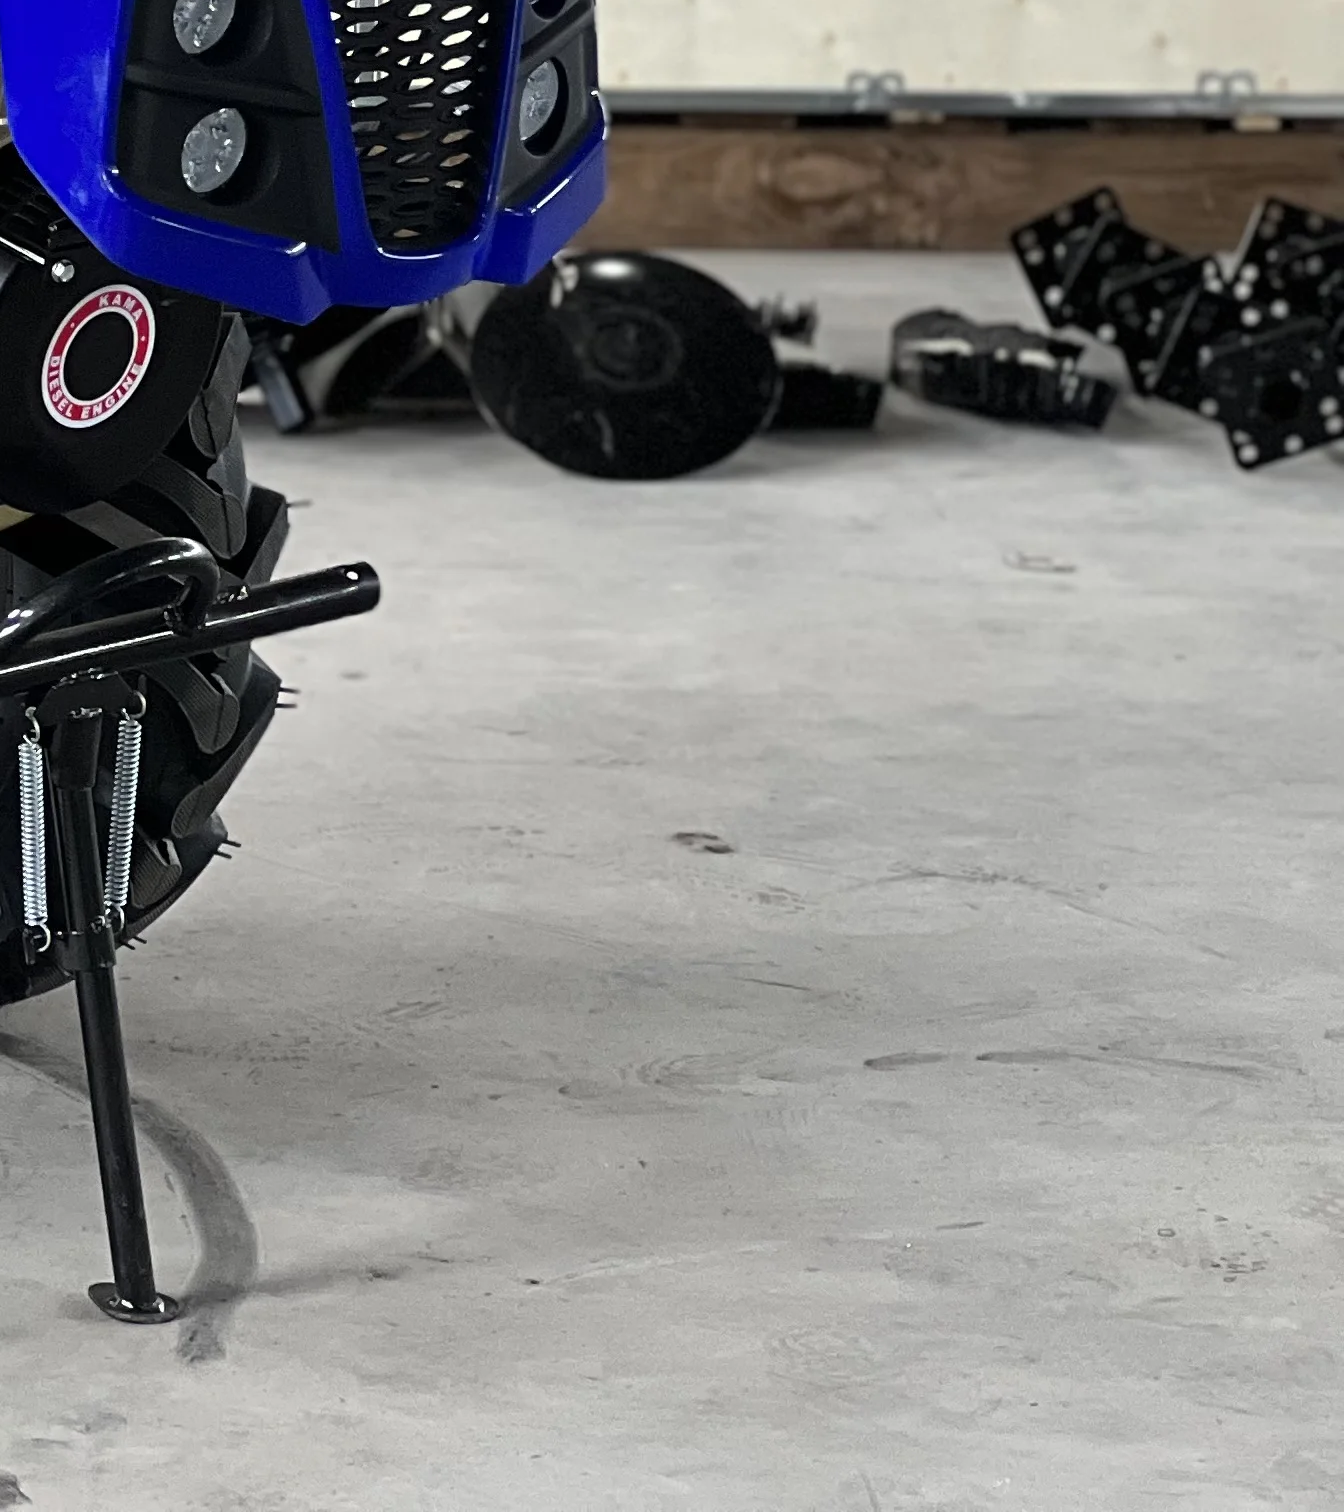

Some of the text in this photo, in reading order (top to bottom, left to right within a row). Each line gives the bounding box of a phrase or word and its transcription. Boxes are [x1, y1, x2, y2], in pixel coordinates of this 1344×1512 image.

[98, 292, 144, 322] KAMA
[49, 355, 143, 420] DIESEL ENGINE
